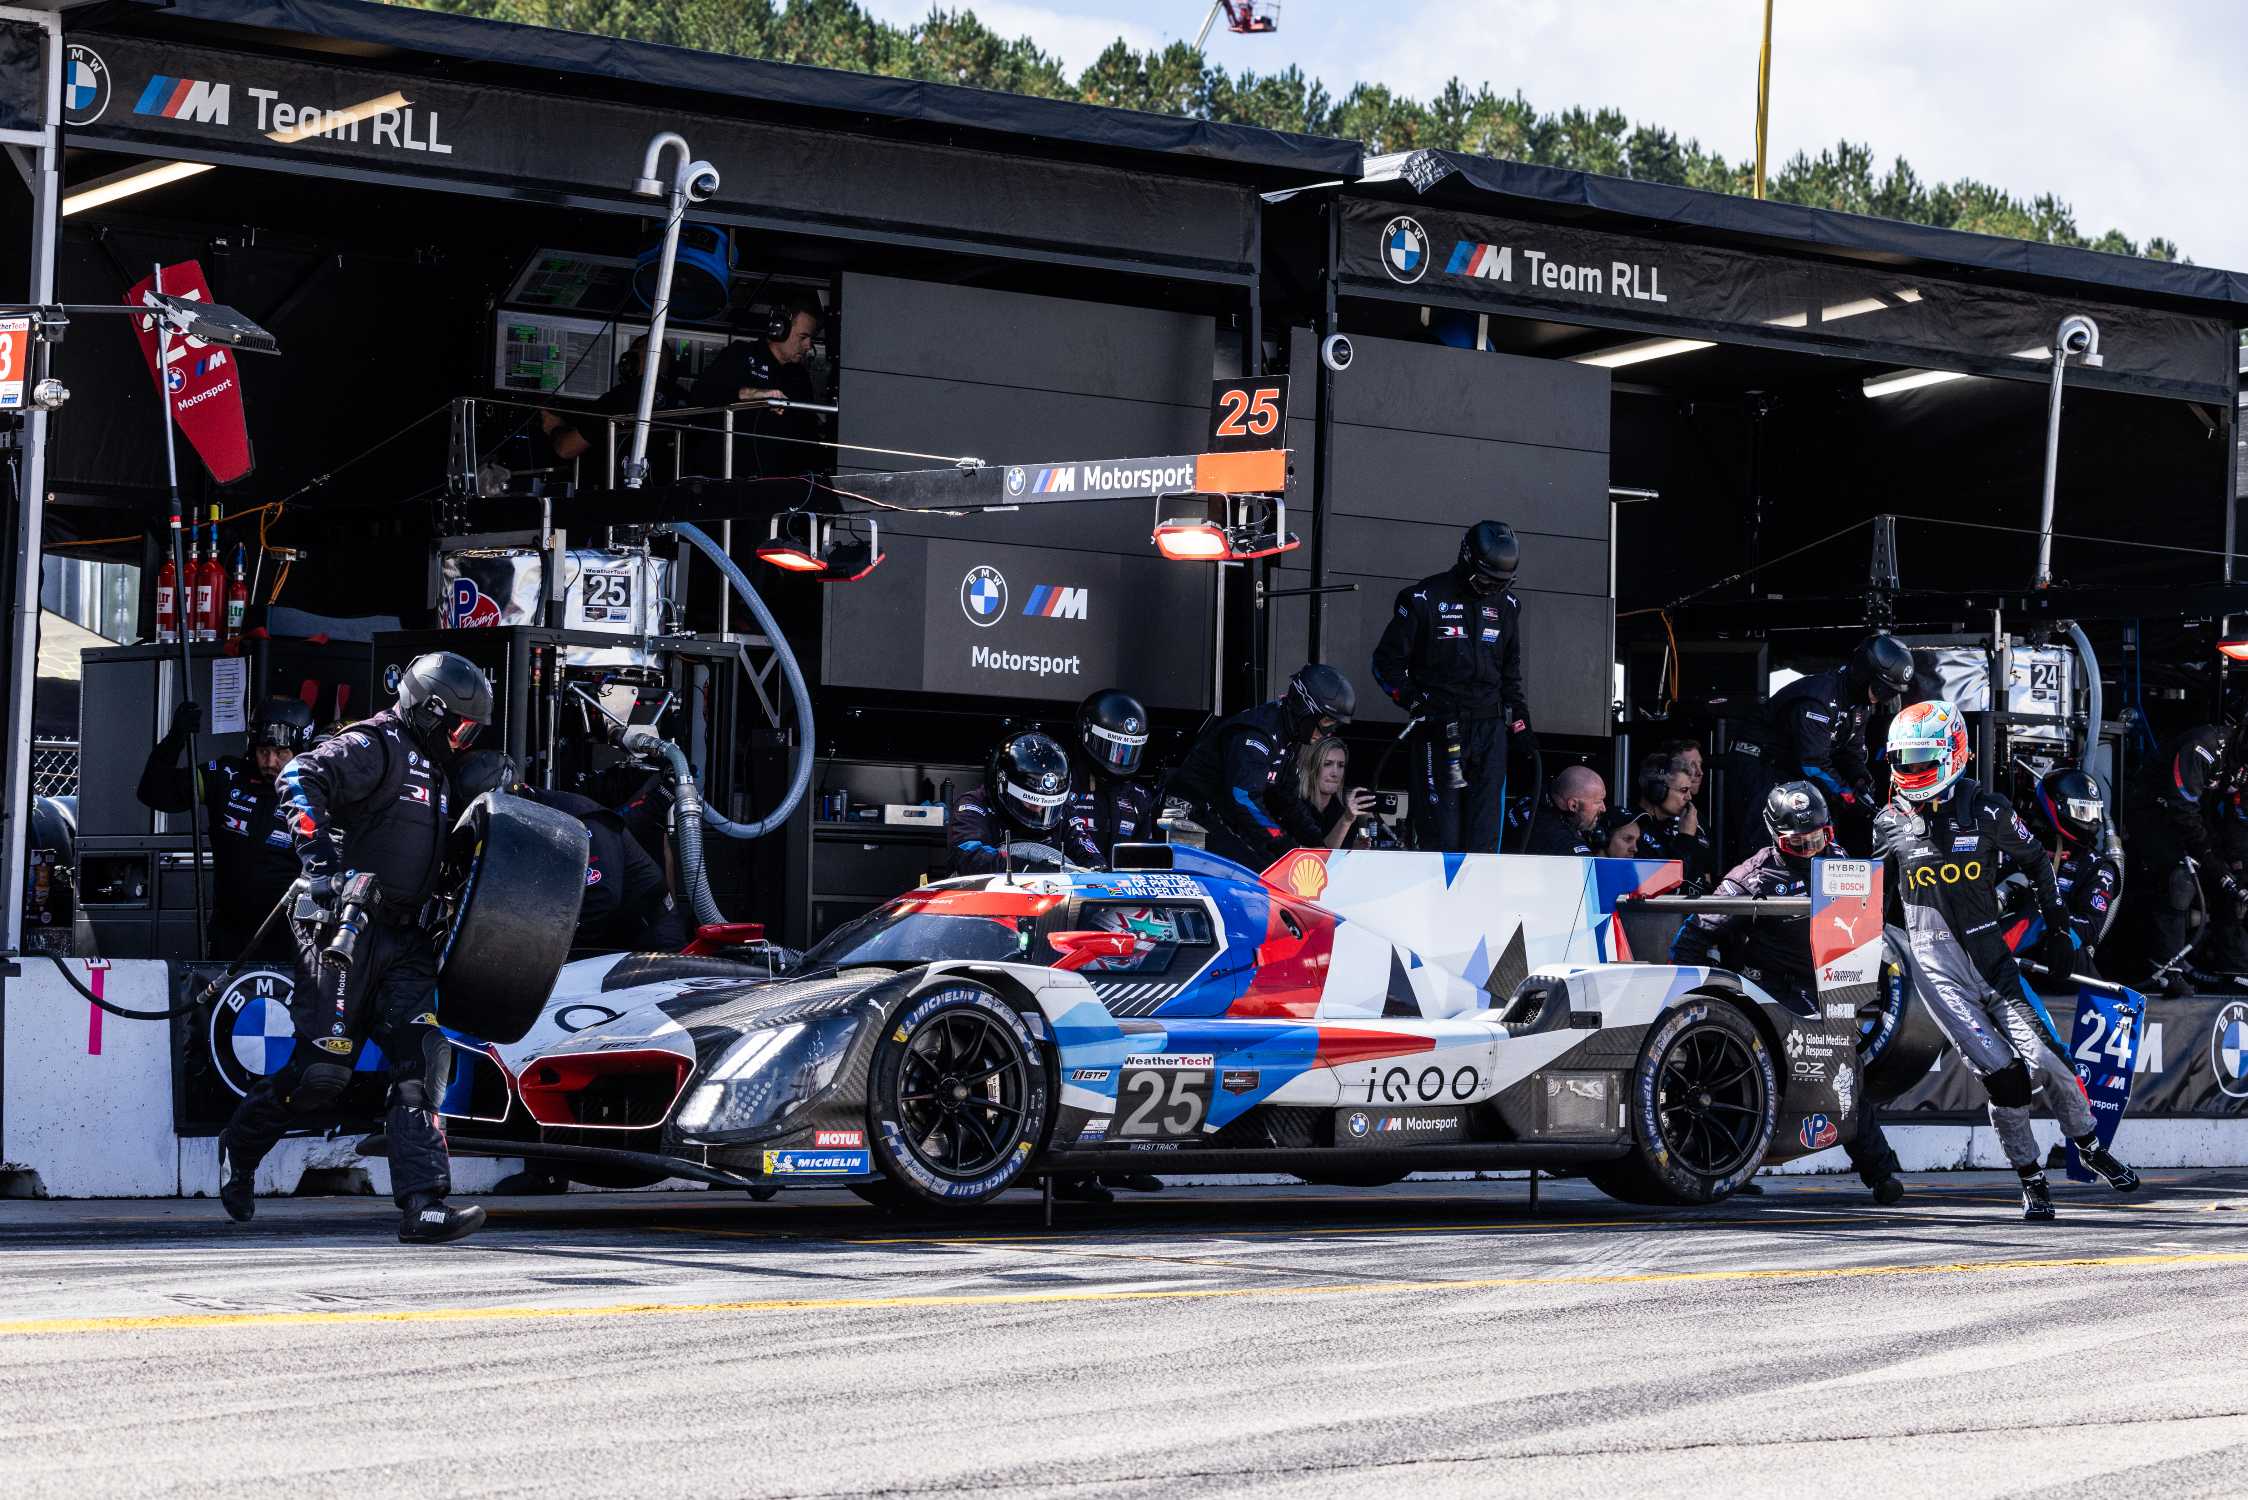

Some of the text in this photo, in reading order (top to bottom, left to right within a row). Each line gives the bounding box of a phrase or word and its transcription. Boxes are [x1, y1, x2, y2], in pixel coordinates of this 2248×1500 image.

[248, 87, 360, 143] Team
[372, 106, 453, 155] RLL
[1387, 219, 1425, 239] BMW
[1524, 249, 1602, 294] Team
[1612, 261, 1668, 303] RLL
[0, 322, 27, 330] herTech
[177, 378, 233, 412] Motorsport
[1215, 387, 1281, 437] 25
[1083, 463, 1194, 493] Motorsport
[588, 575, 627, 606] 25
[968, 568, 1003, 587] BMW
[971, 645, 1080, 677] Motorsport
[2034, 664, 2058, 690] 24
[1132, 879, 1150, 888] DE
[1840, 882, 1864, 891] BOSCH
[1906, 861, 1982, 891] iQOO
[1123, 887, 1148, 896] VAN
[336, 970, 347, 996] Motor
[913, 990, 976, 1023] MICHELIN
[1806, 1033, 1850, 1047] Global Medical
[2074, 1008, 2133, 1069] 24
[1124, 1055, 1213, 1066] WeatherTech
[1805, 1046, 1833, 1058] Response
[1084, 1071, 1108, 1079] GTP
[1794, 1061, 1825, 1075] OZ
[1366, 1065, 1479, 1103] iQOO
[1119, 1070, 1206, 1136] 25
[1406, 1116, 1459, 1132] Motorsport
[1802, 1113, 1828, 1147] VP
[817, 1132, 861, 1146] MOTUL
[797, 1156, 862, 1169] MICHELIN
[951, 1164, 1015, 1197] MICHELIN
[419, 1210, 446, 1225] PUMA
